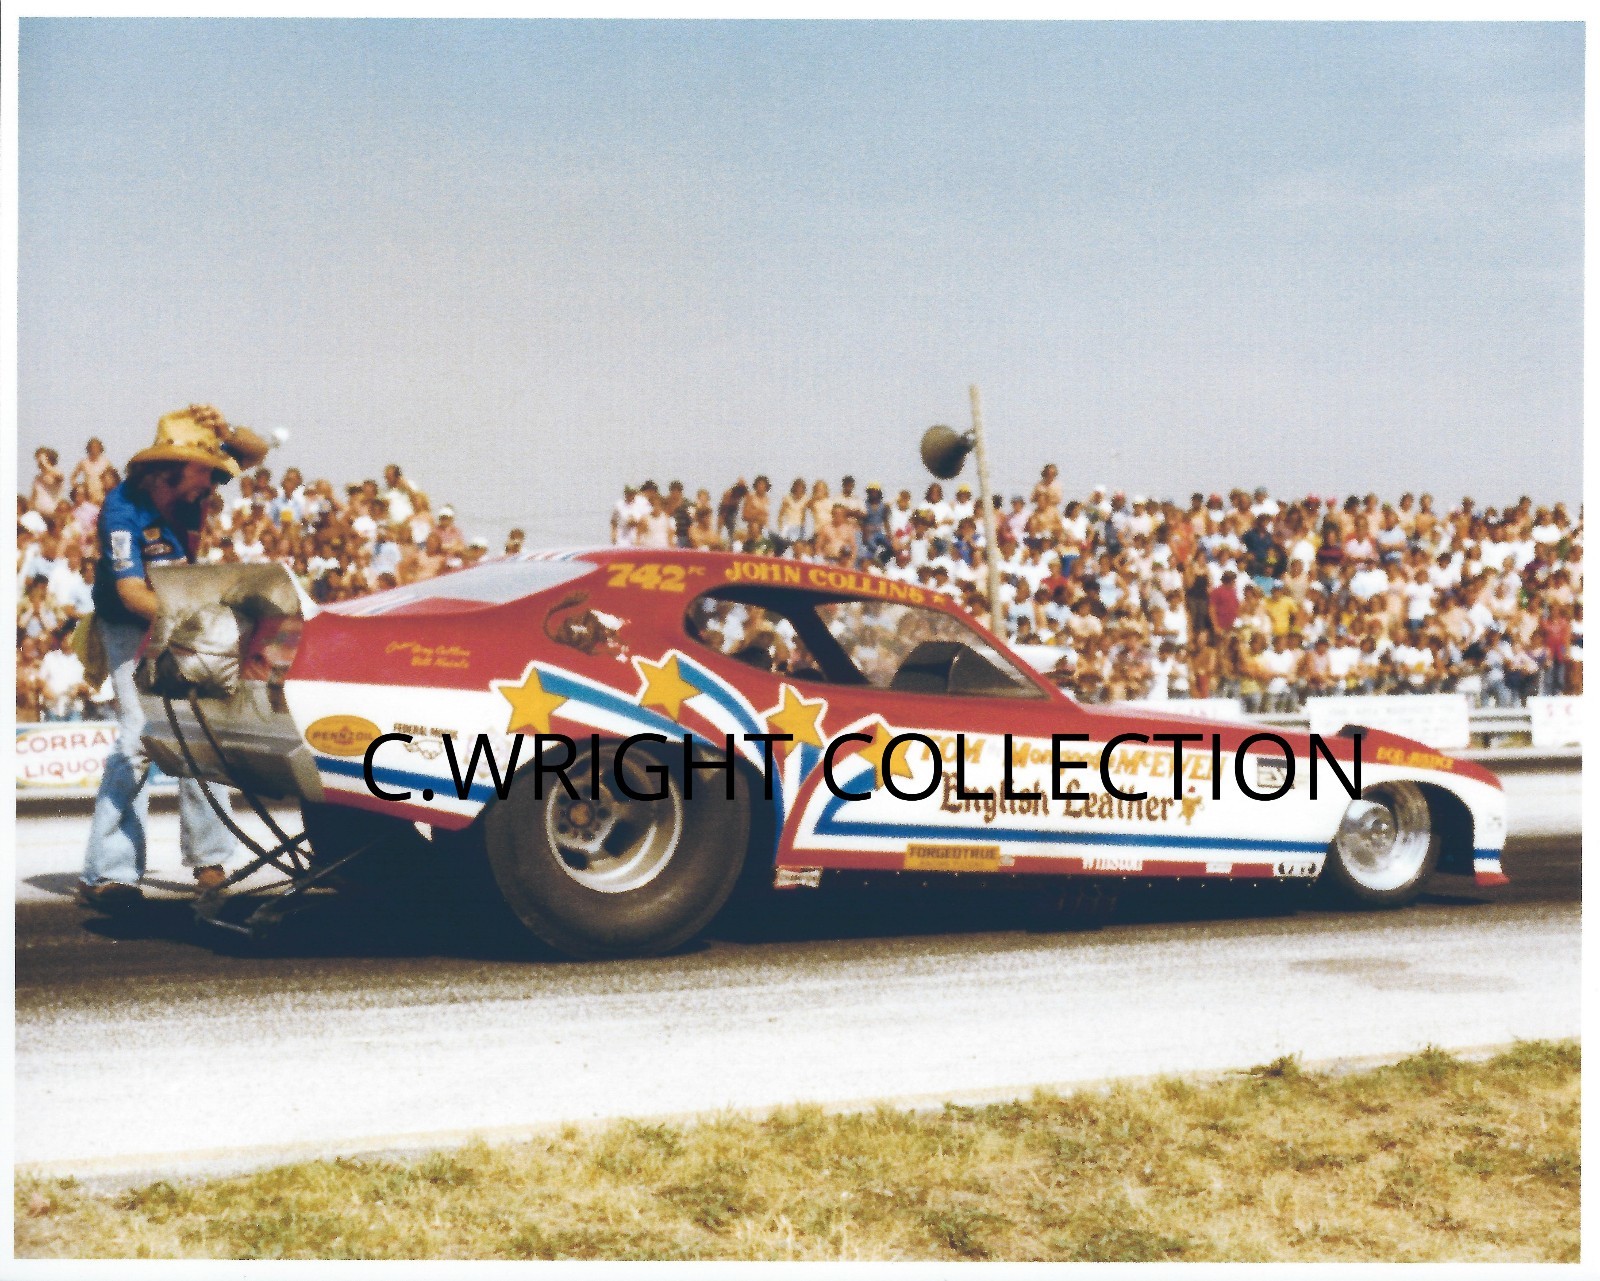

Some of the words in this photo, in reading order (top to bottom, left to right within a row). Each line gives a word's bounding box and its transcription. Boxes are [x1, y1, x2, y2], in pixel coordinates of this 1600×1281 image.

[607, 562, 686, 593] 742
[725, 561, 800, 583] JOHN
[808, 567, 925, 604] COLLINS
[921, 735, 986, 764] TOM
[24, 757, 107, 779] LIQUO
[940, 771, 1050, 824] English
[1063, 778, 1174, 822] Leather
